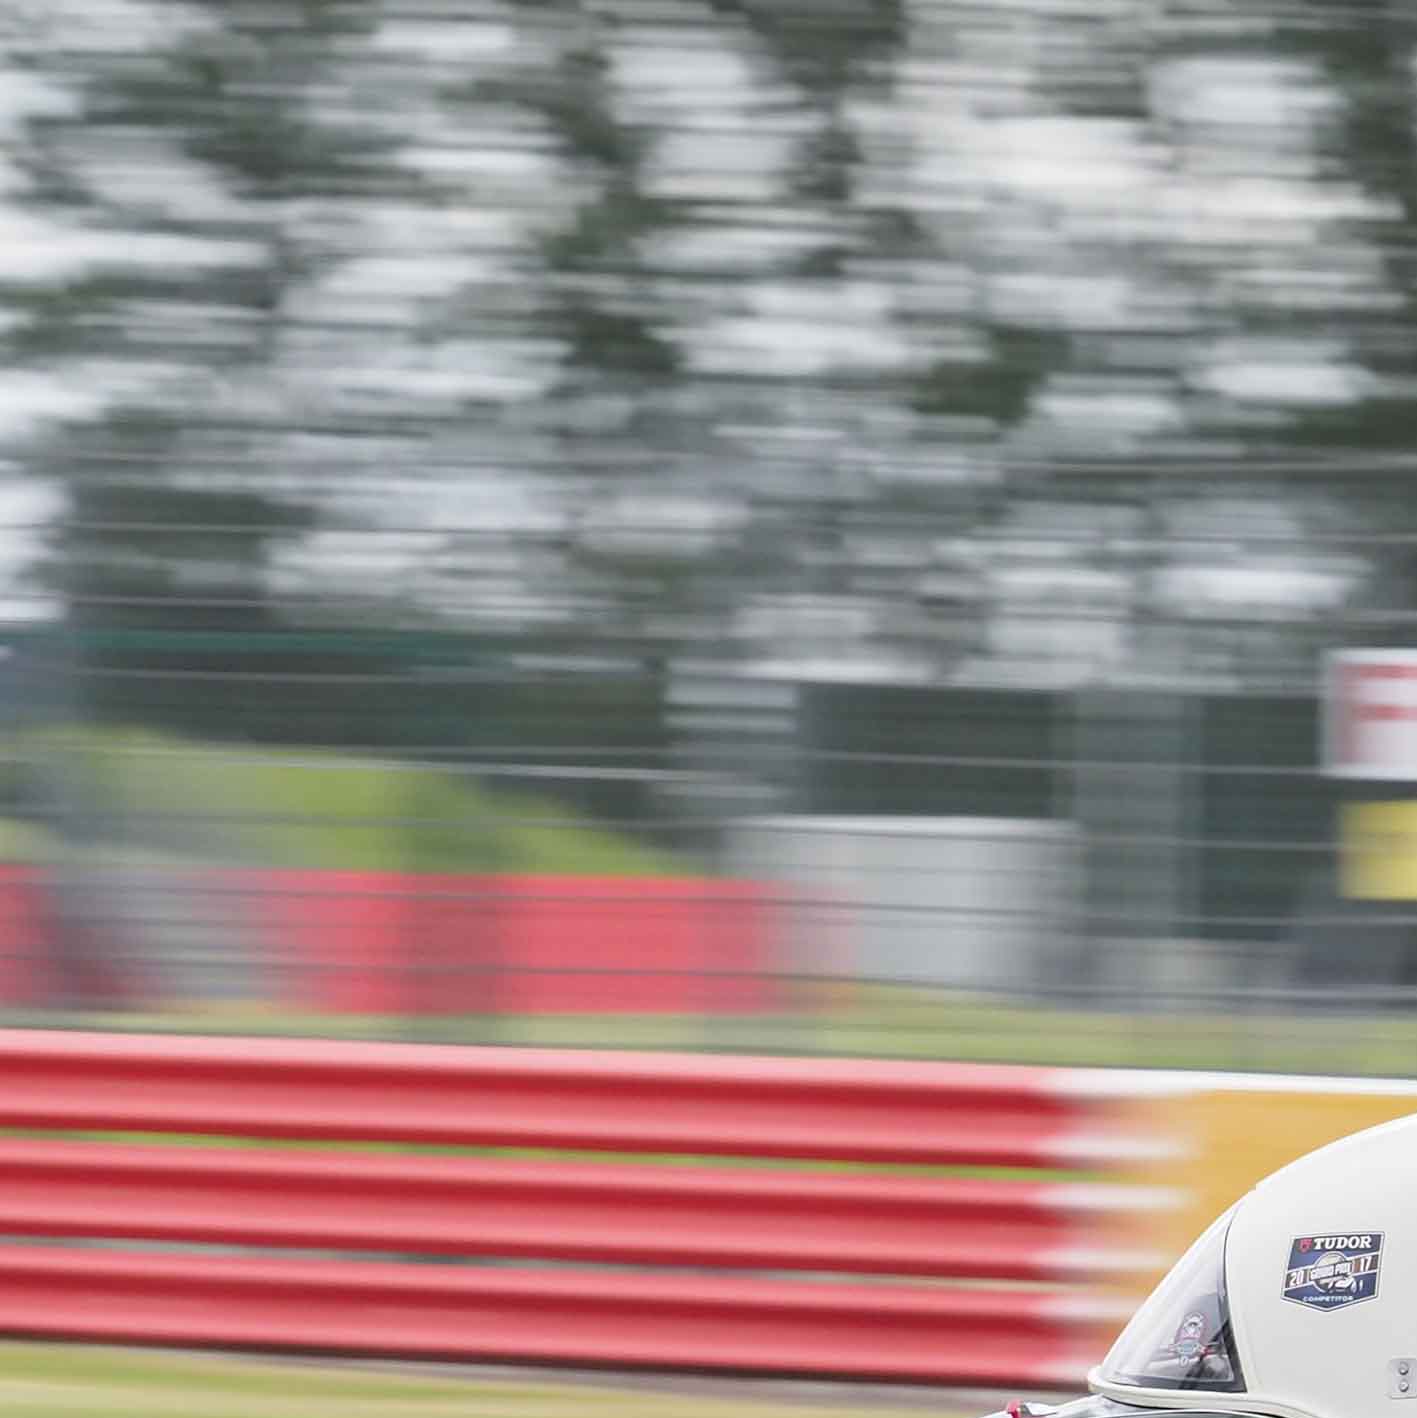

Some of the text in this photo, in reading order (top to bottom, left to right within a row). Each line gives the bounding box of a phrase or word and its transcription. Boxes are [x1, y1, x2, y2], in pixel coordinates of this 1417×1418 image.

[1313, 1235, 1372, 1250] TUDOR
[1289, 1270, 1304, 1286] 20
[1360, 1256, 1372, 1272] 17
